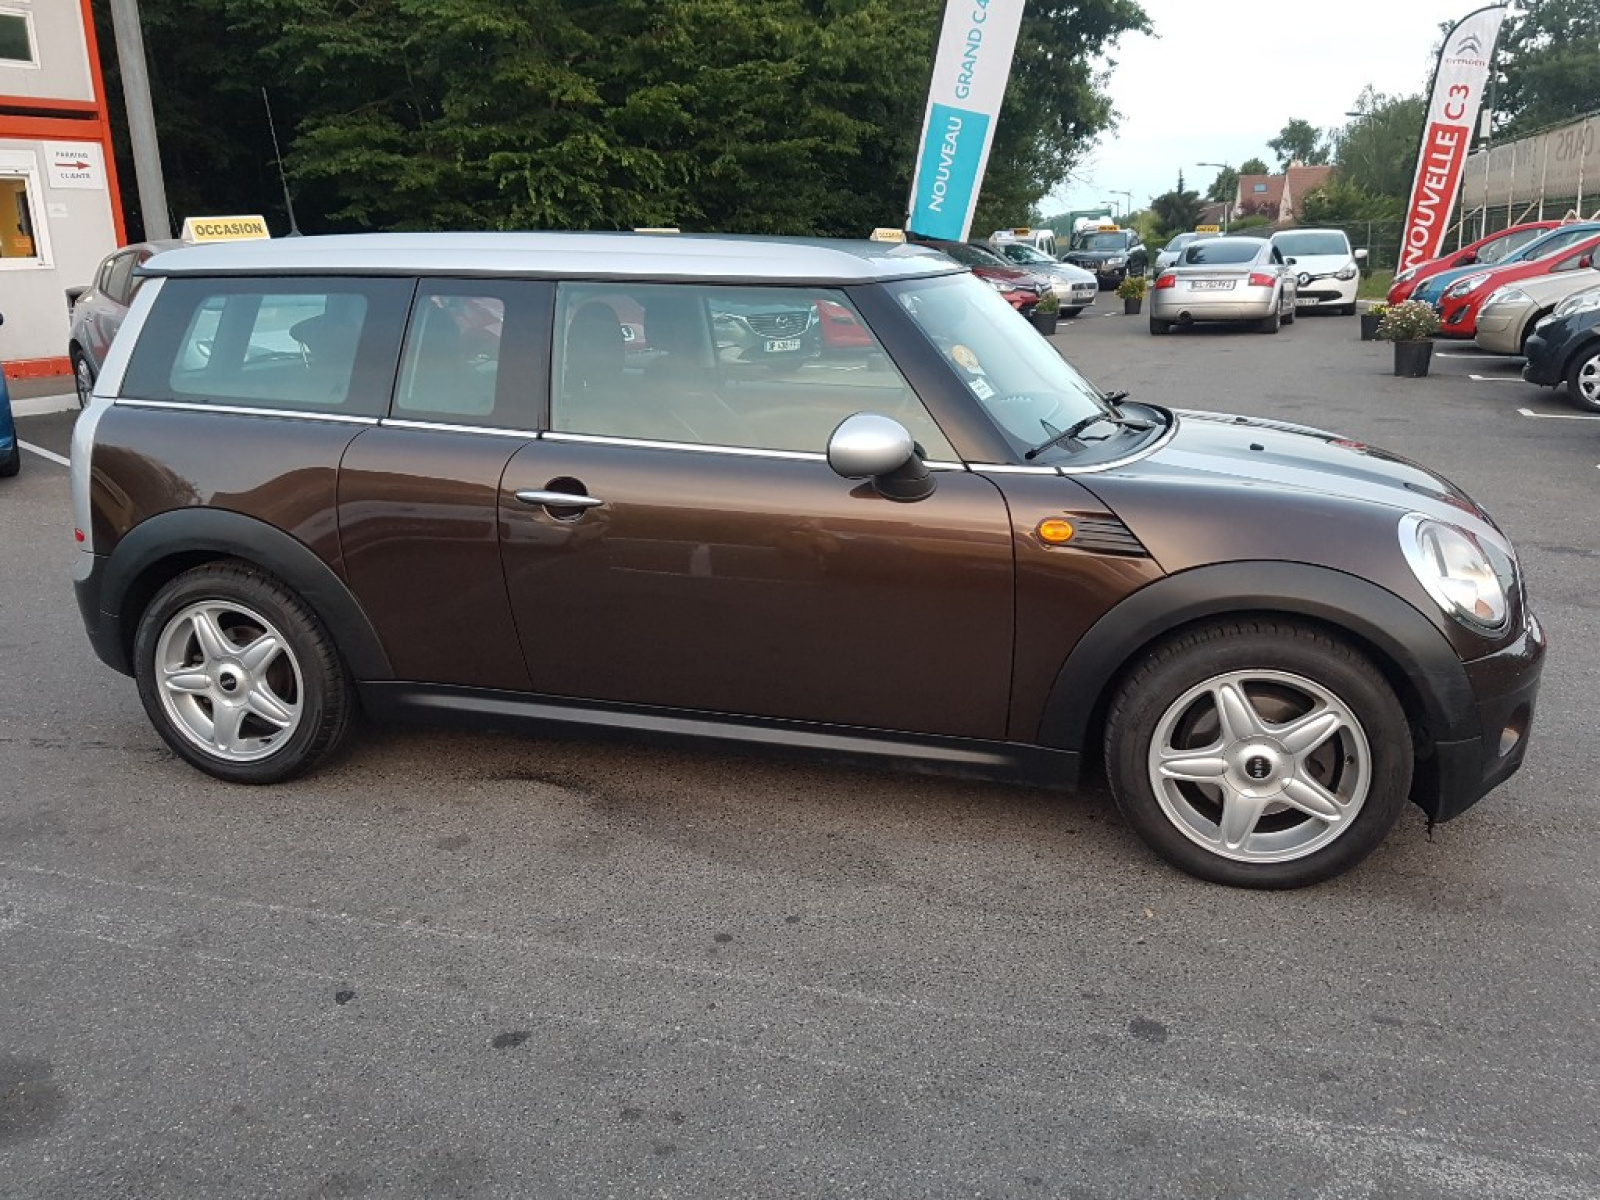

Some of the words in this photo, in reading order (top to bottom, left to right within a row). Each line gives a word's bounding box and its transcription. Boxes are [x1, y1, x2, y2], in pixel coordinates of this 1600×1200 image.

[928, 116, 962, 212] NOUVEAU
[956, 28, 982, 100] GRAND
[973, 0, 990, 24] C4
[1404, 130, 1459, 267] NOUVELLE
[1444, 84, 1470, 120] C3
[195, 223, 263, 236] OCCASION
